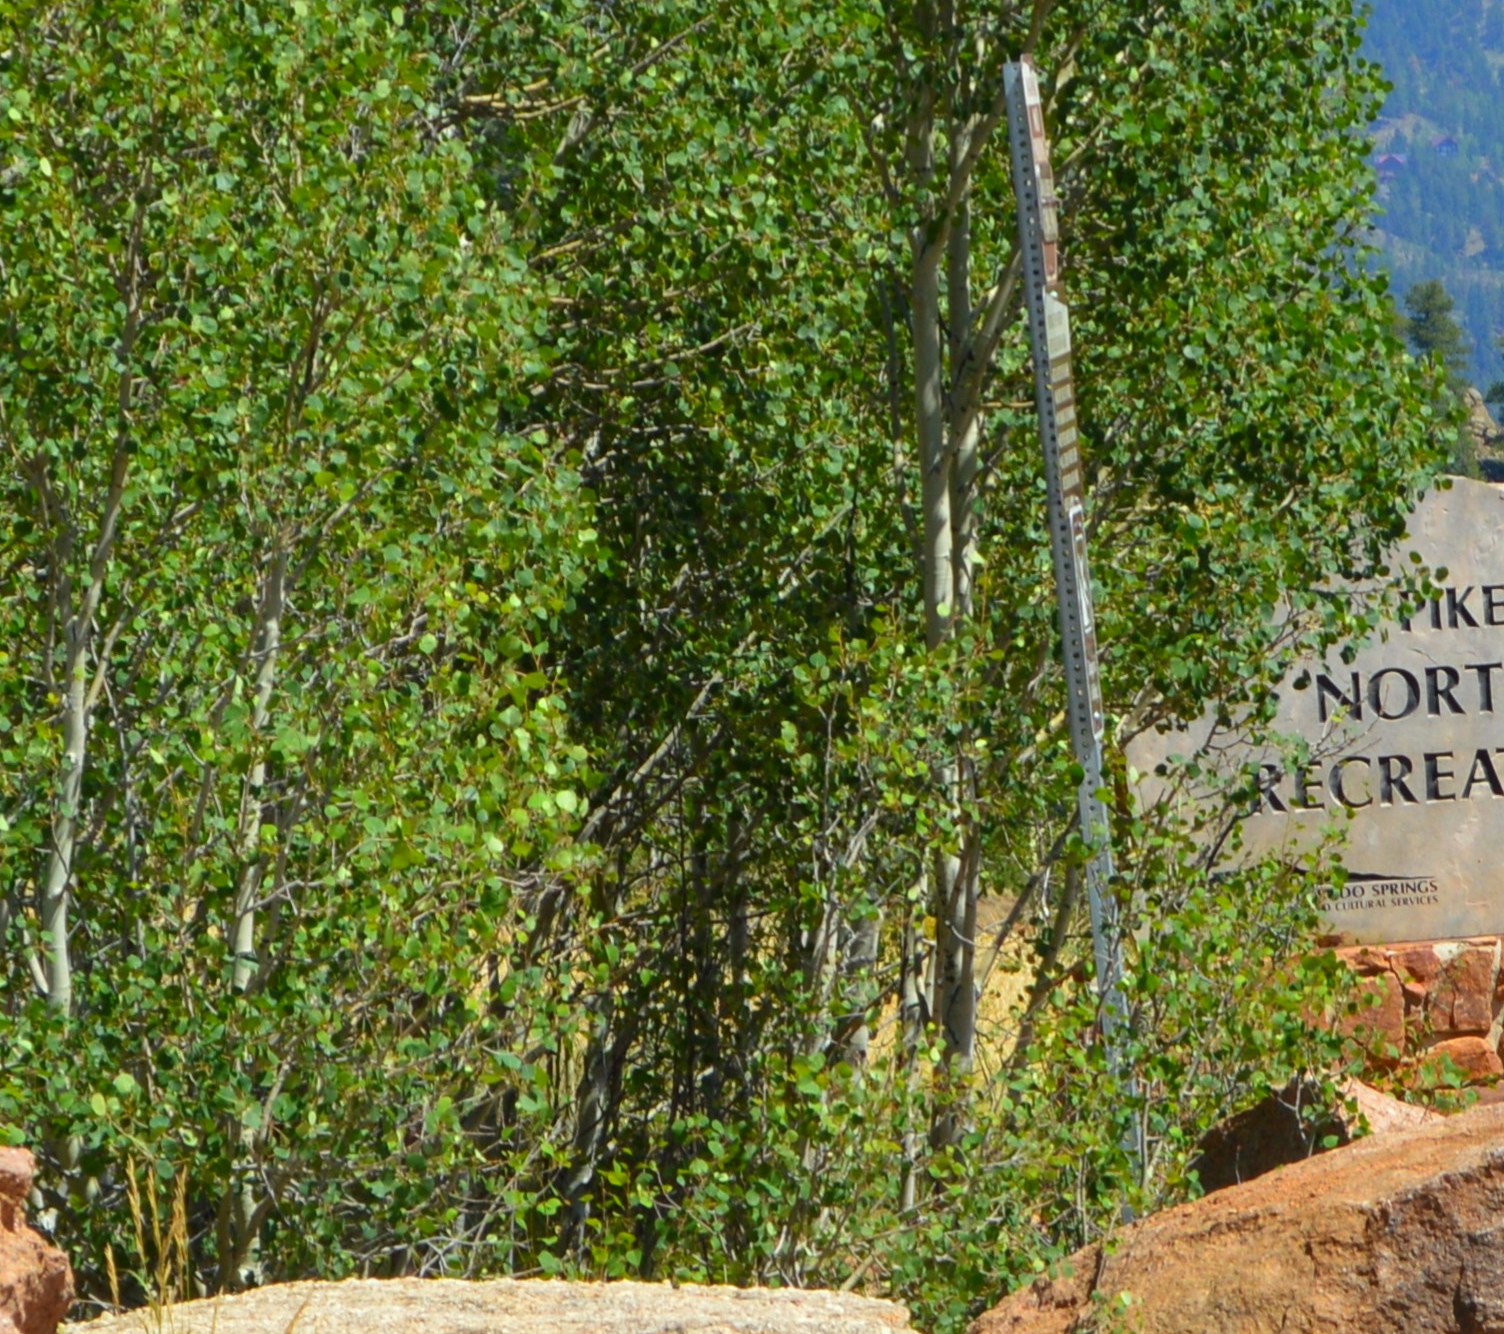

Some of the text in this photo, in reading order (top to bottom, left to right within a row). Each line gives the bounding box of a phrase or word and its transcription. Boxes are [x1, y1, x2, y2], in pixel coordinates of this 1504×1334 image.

[1371, 880, 1438, 897] SPRINGS
[1335, 898, 1386, 911] CULTURAL
[1391, 894, 1439, 907] SERVICES
